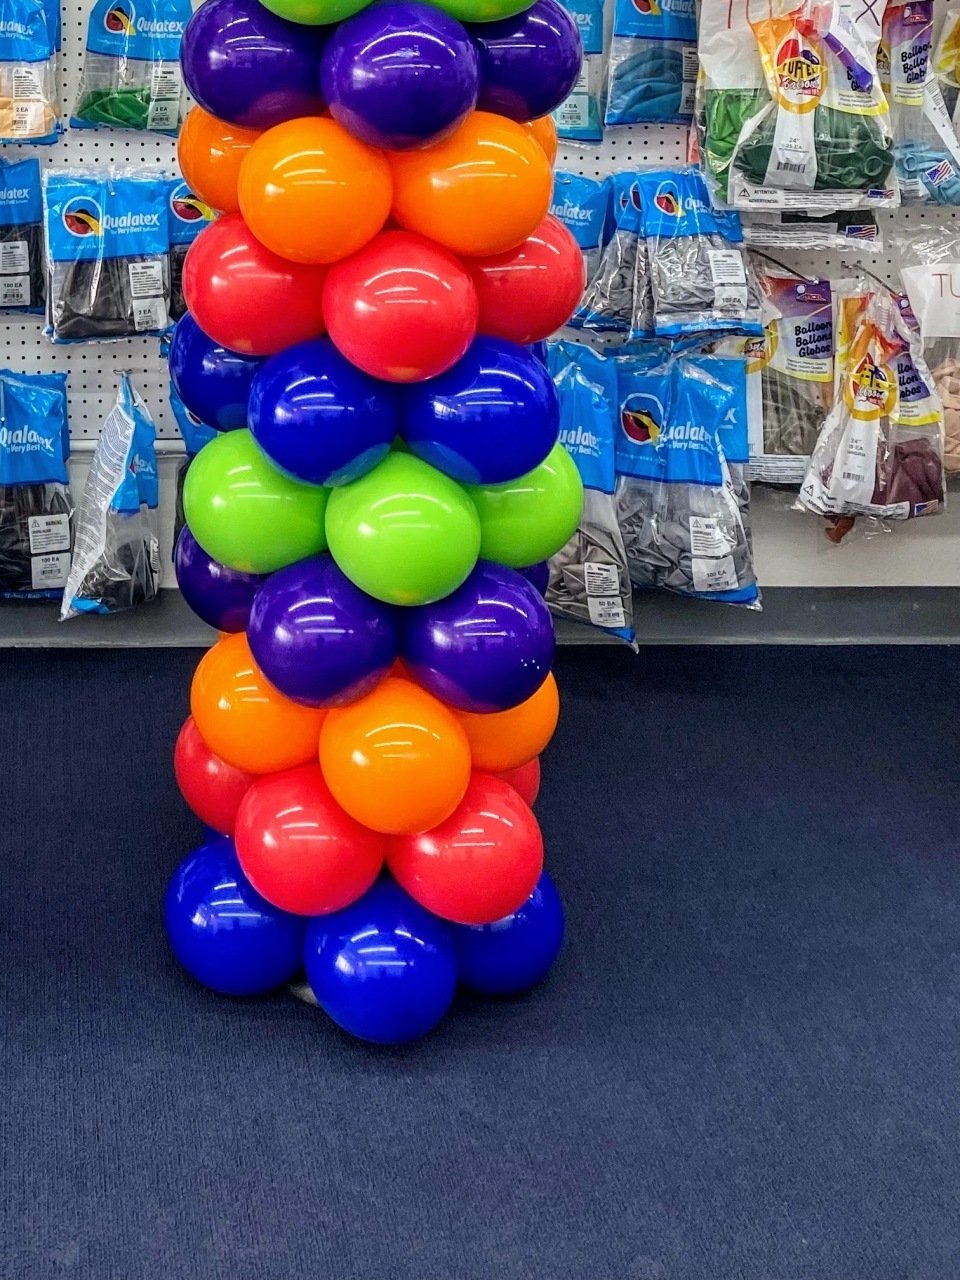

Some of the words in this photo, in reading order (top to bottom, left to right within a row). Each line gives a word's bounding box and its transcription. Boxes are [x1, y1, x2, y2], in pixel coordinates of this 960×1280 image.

[103, 212, 160, 228] Qualatex
[118, 227, 130, 235] Very
[795, 321, 832, 336] Balloon
[799, 344, 831, 357] Globos
[10, 443, 25, 453] Very
[26, 443, 41, 452] Best
